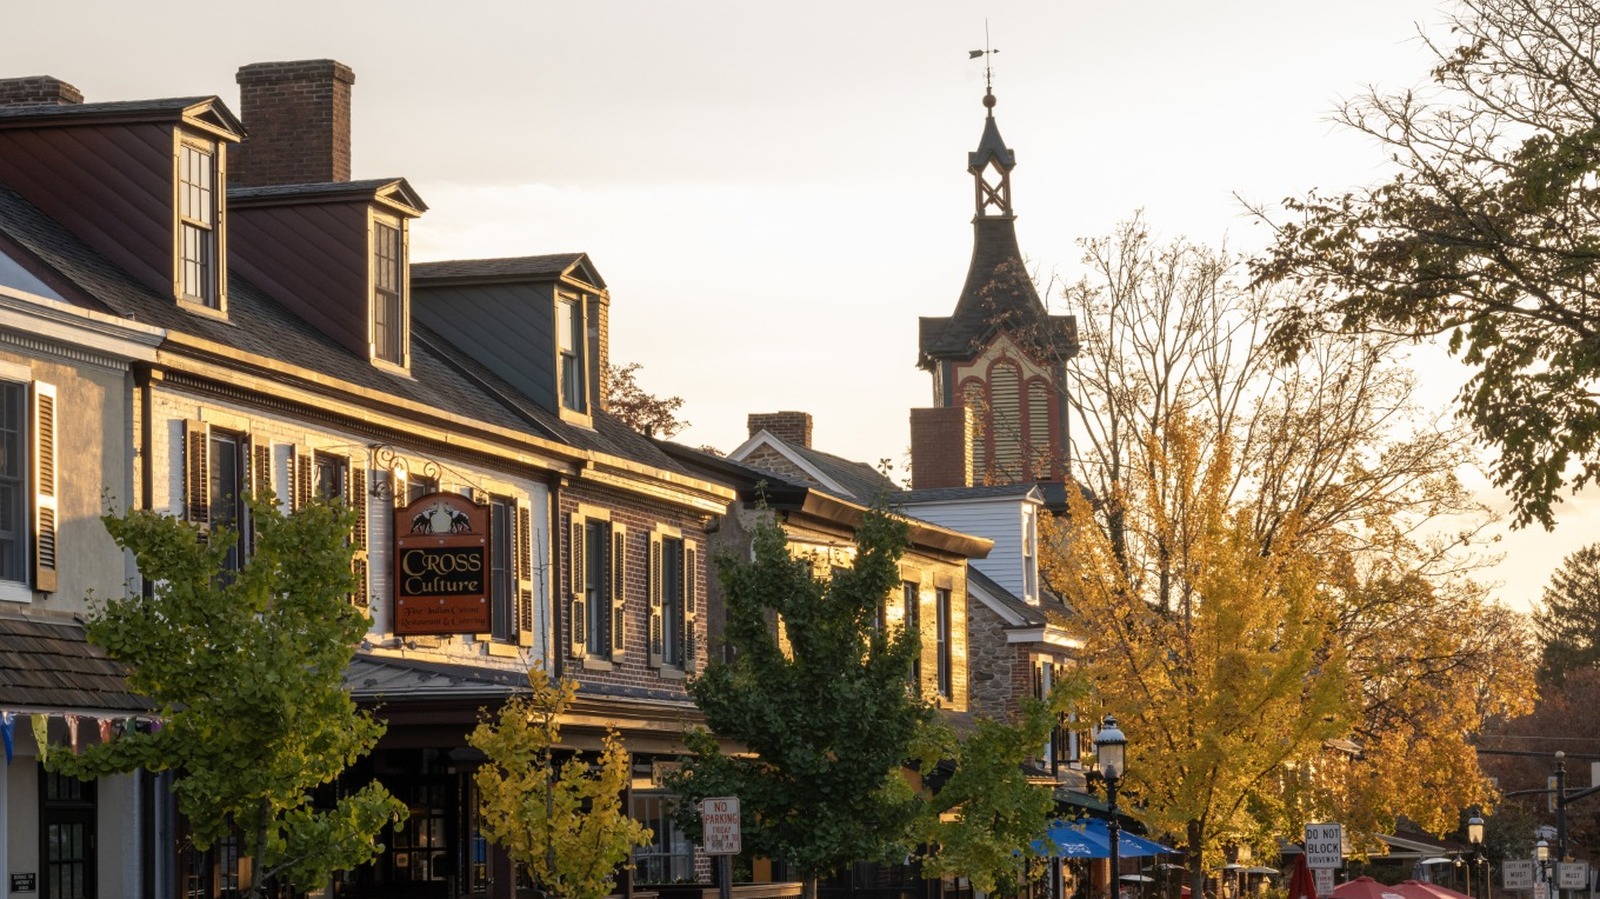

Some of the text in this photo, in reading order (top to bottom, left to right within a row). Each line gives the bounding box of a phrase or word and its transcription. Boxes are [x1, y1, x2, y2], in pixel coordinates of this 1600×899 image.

[405, 576, 479, 595] Culture
[401, 617, 486, 629] Restaurant & Catering
[714, 802, 728, 813] NO
[705, 814, 738, 825] PARKING
[1307, 828, 1339, 840] DO NOT
[1308, 843, 1339, 854] BLOCK
[1308, 856, 1339, 864] DRIVEWAY
